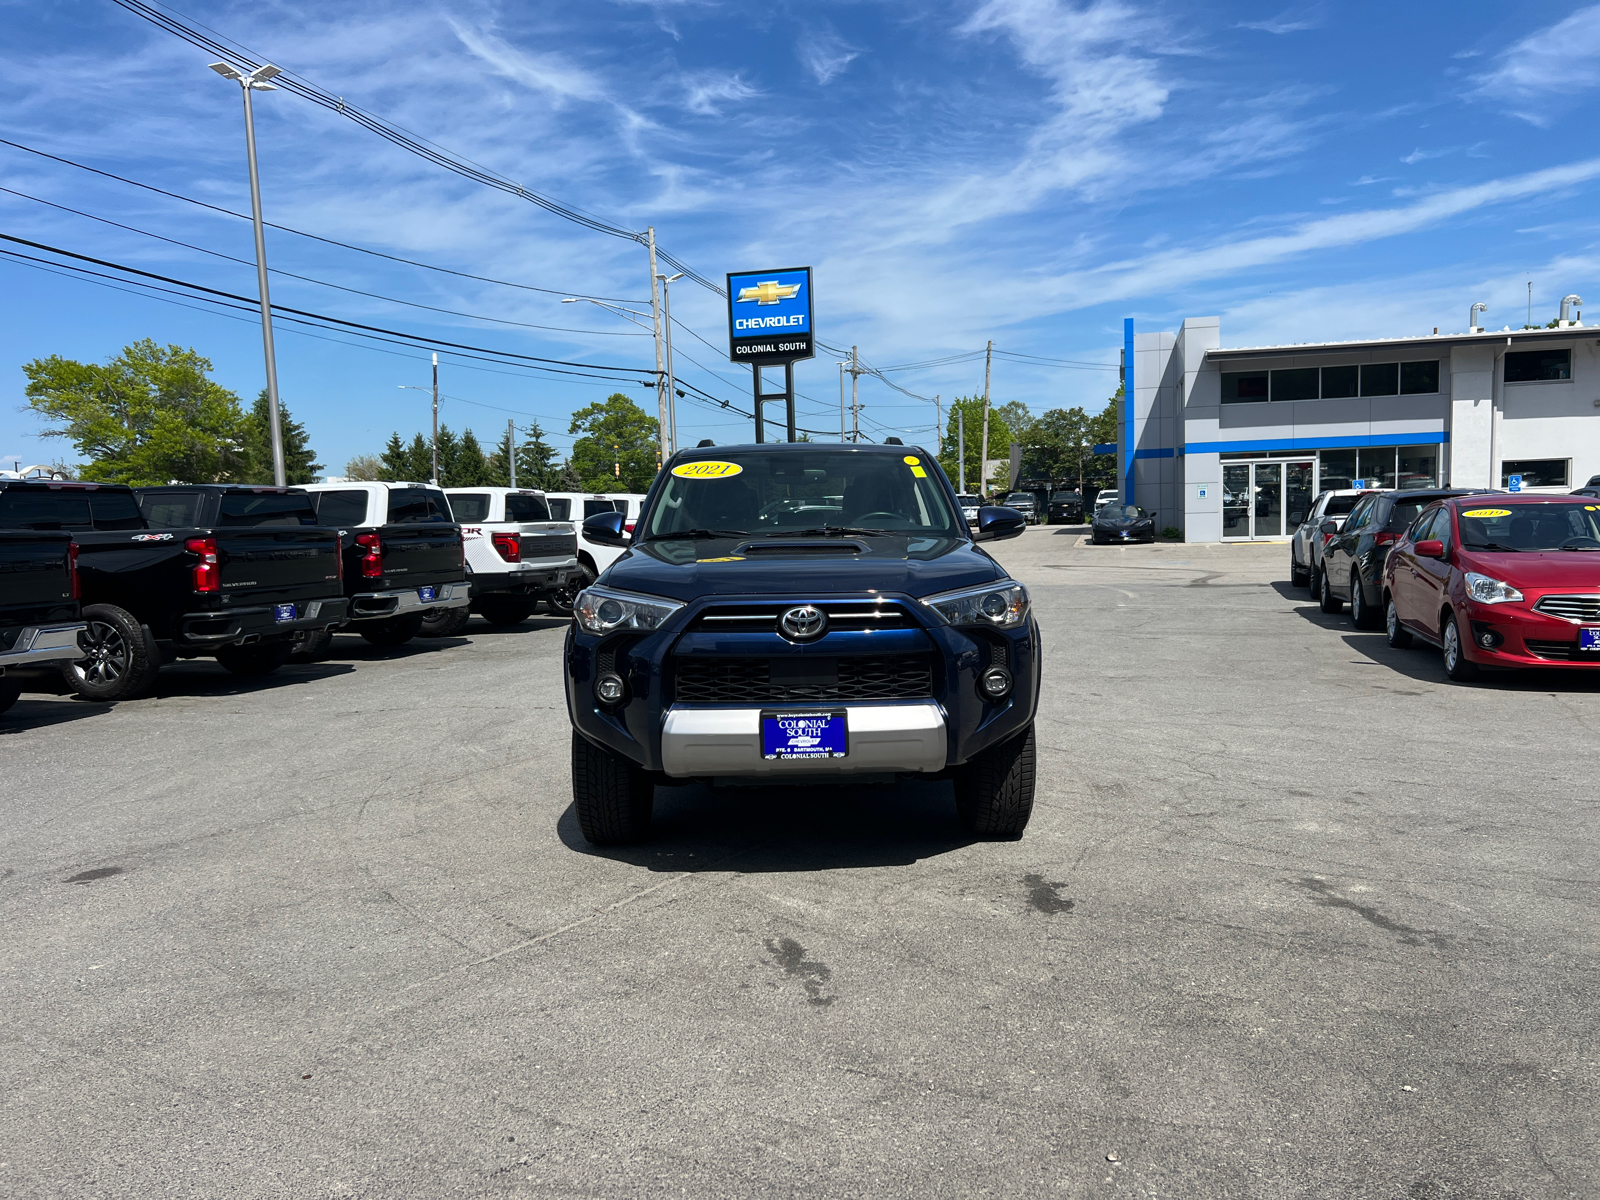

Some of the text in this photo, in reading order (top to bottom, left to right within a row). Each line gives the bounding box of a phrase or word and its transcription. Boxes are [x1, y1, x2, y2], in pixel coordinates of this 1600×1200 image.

[736, 314, 804, 330] CHEVROLET
[736, 342, 806, 354] COLONIAL SOUTH
[683, 465, 731, 475] 2021
[778, 720, 829, 728] COLONIAL
[786, 728, 821, 736] SOUTH
